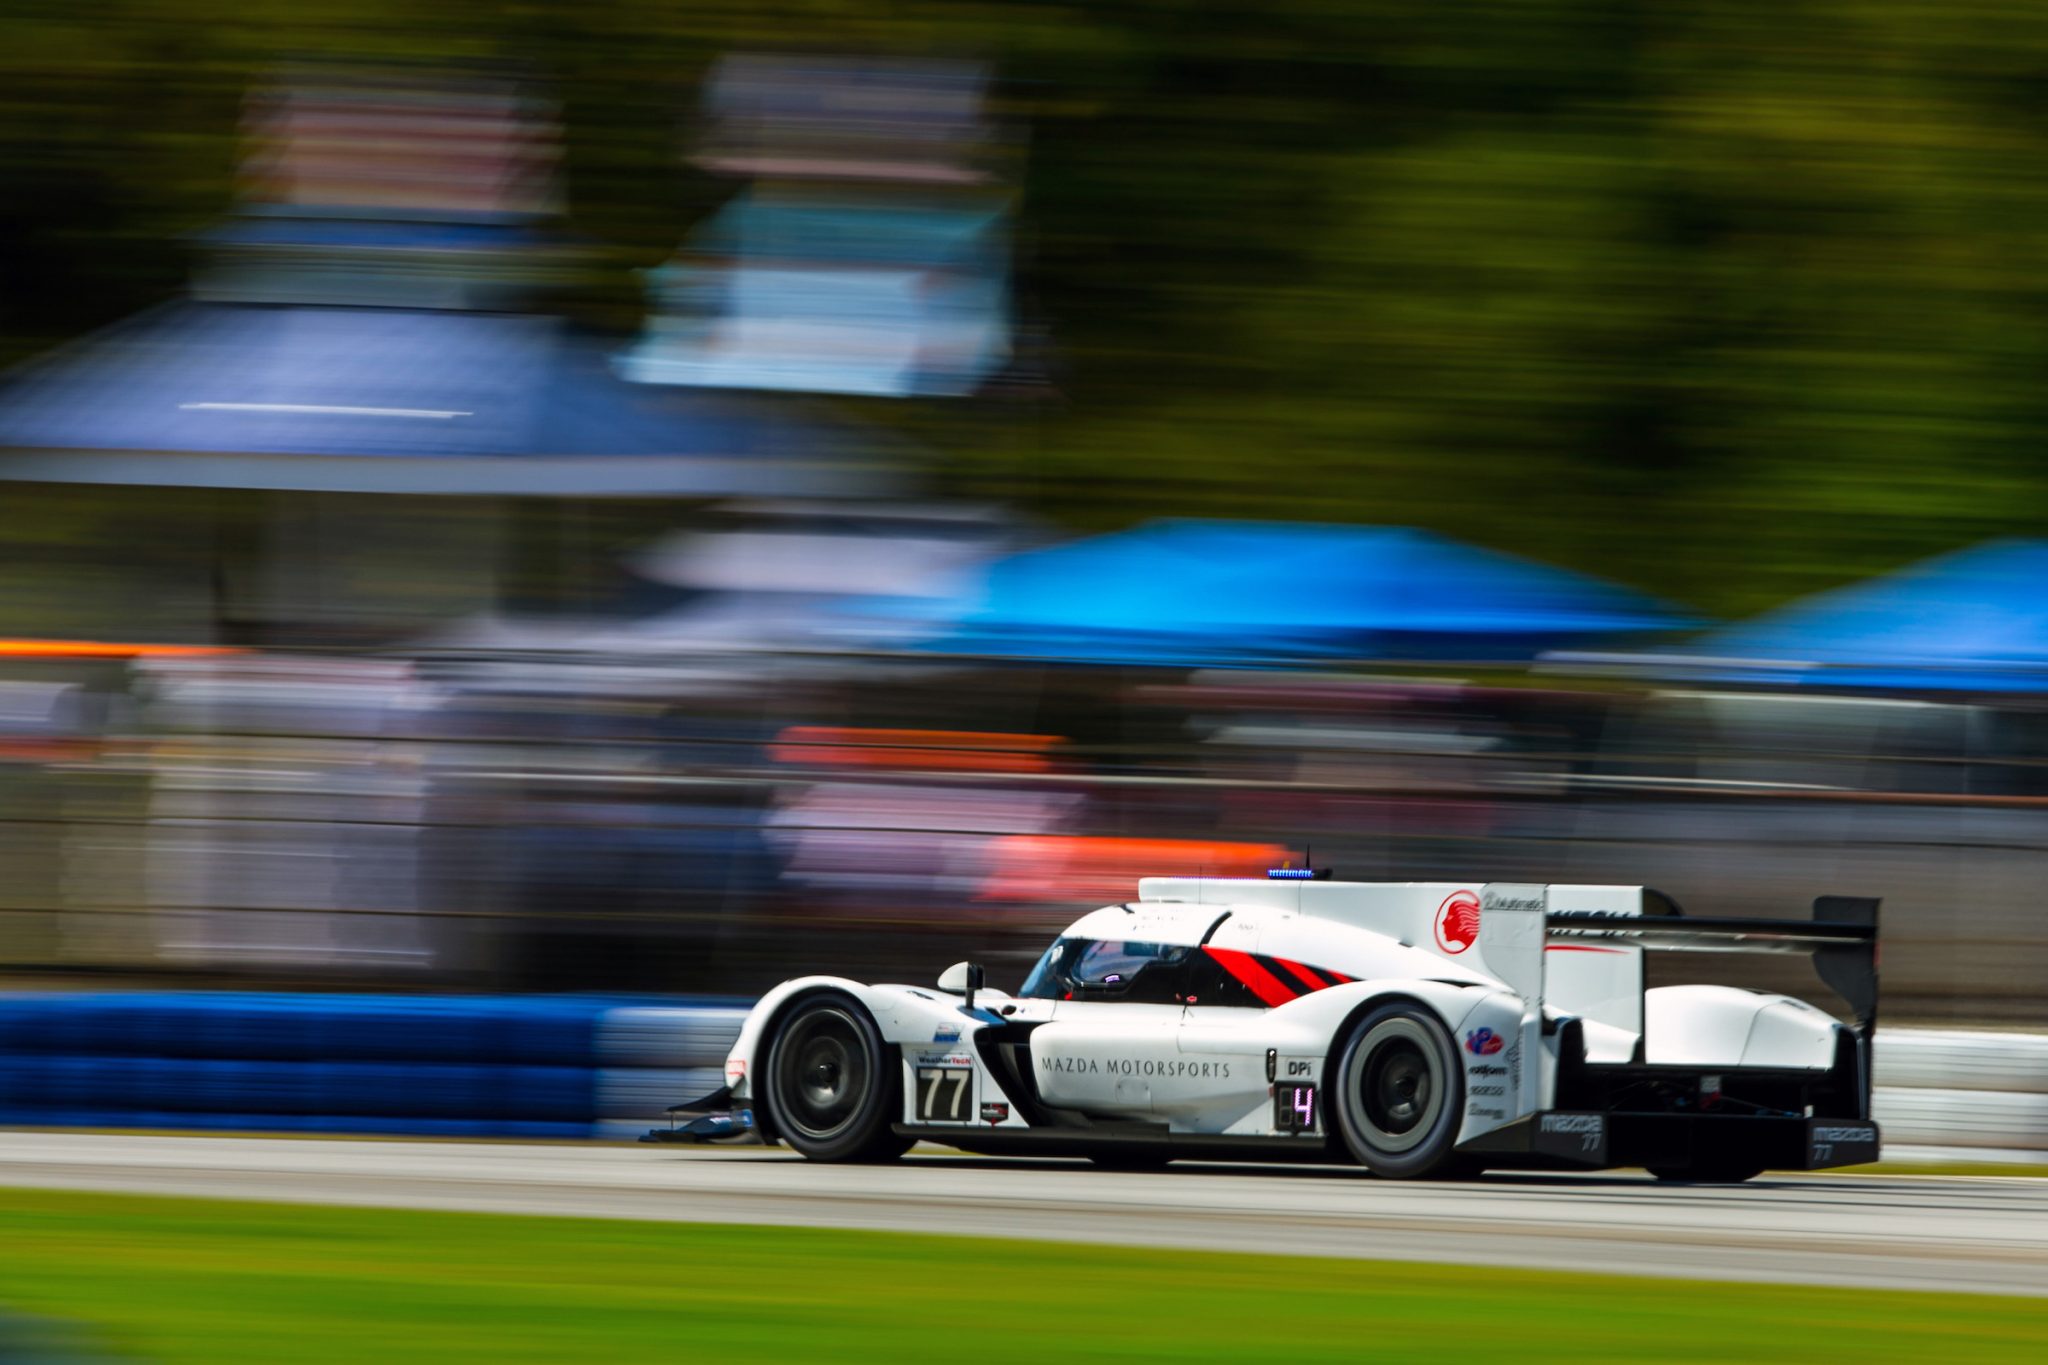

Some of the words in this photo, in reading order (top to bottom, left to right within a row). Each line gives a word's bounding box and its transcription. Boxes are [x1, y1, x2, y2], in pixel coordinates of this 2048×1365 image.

[918, 1055, 972, 1066] WeatherTech
[1042, 1058, 1099, 1074] MAZDA
[1107, 1060, 1231, 1079] MOTORSPORTS
[920, 1068, 970, 1119] 77
[1582, 1133, 1603, 1152] 77
[1813, 1144, 1833, 1161] 77
